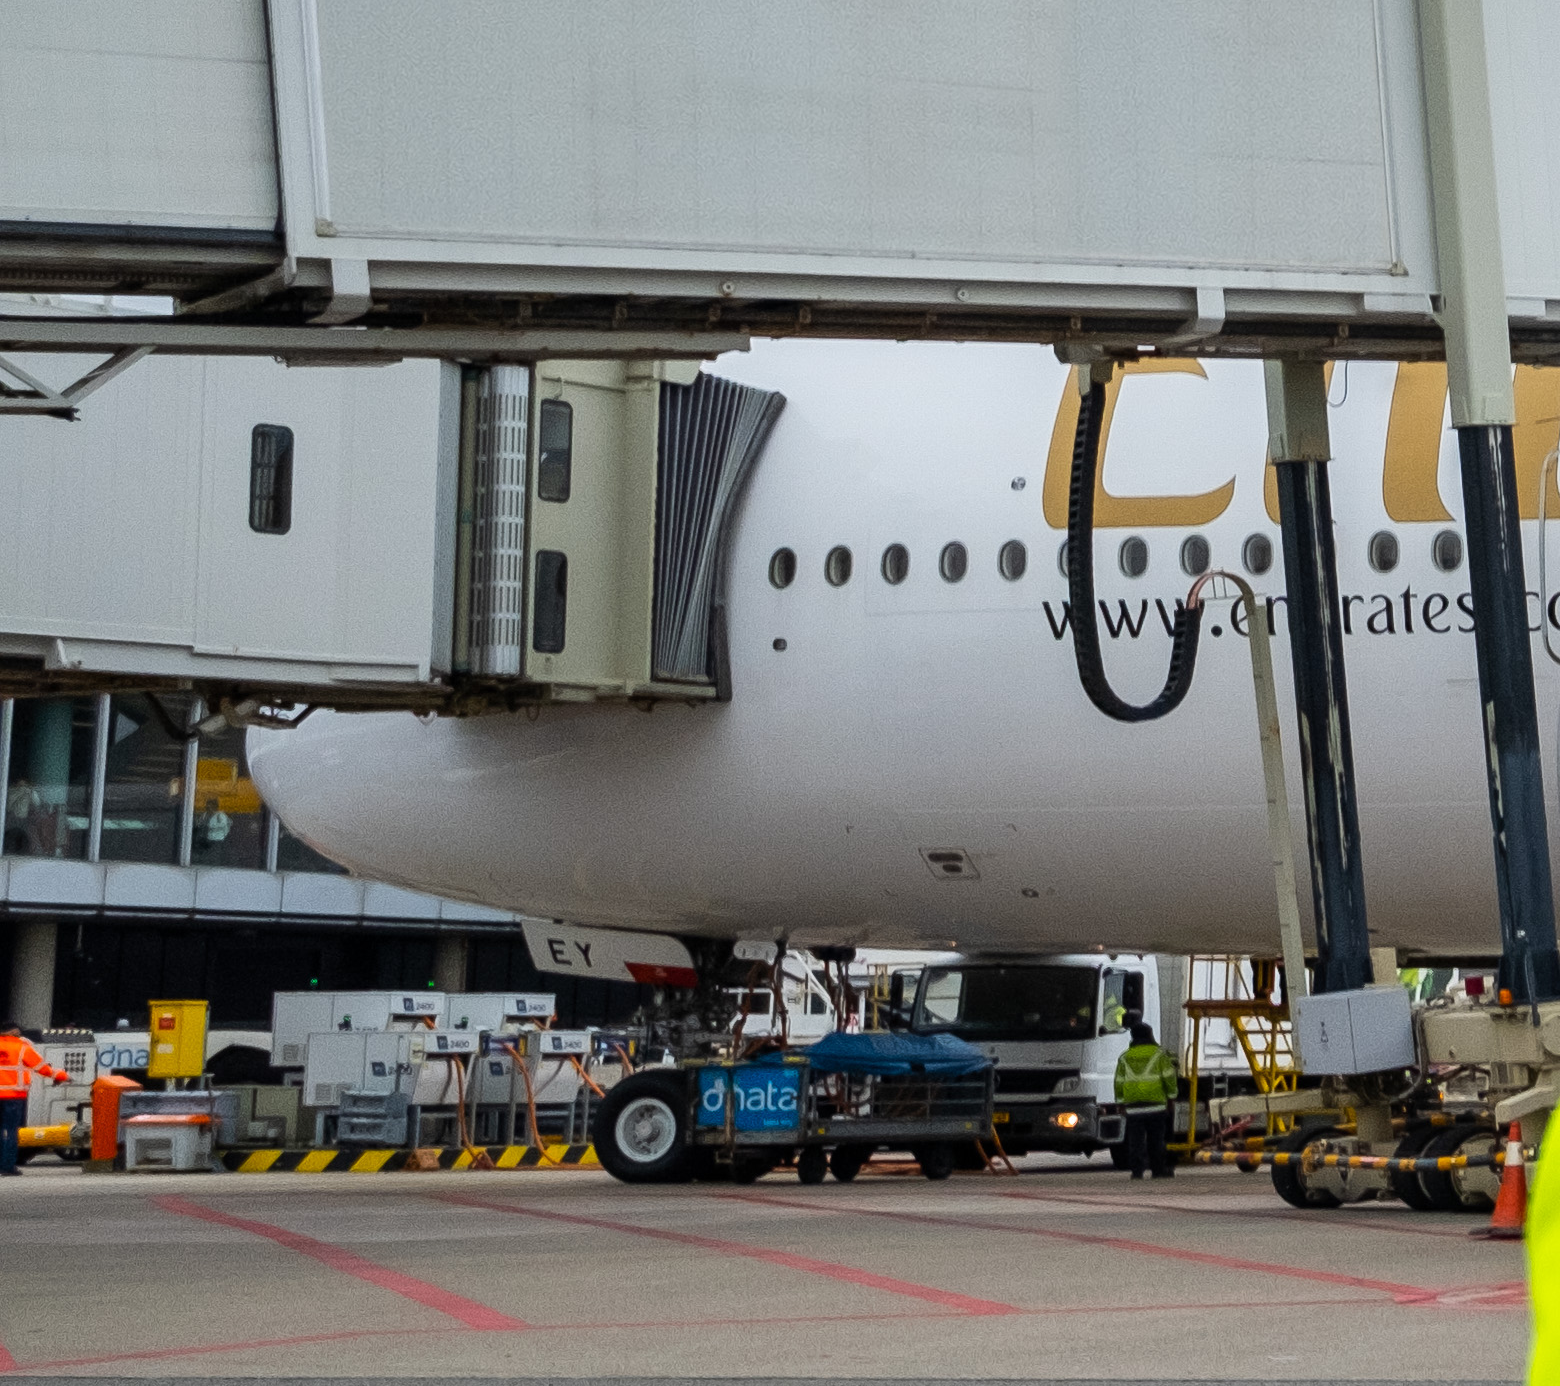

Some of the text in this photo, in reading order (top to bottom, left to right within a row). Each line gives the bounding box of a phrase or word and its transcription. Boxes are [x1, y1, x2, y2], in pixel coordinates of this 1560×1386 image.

[547, 938, 593, 968] EY
[96, 1046, 148, 1068] dna
[703, 1078, 798, 1111] dnata
